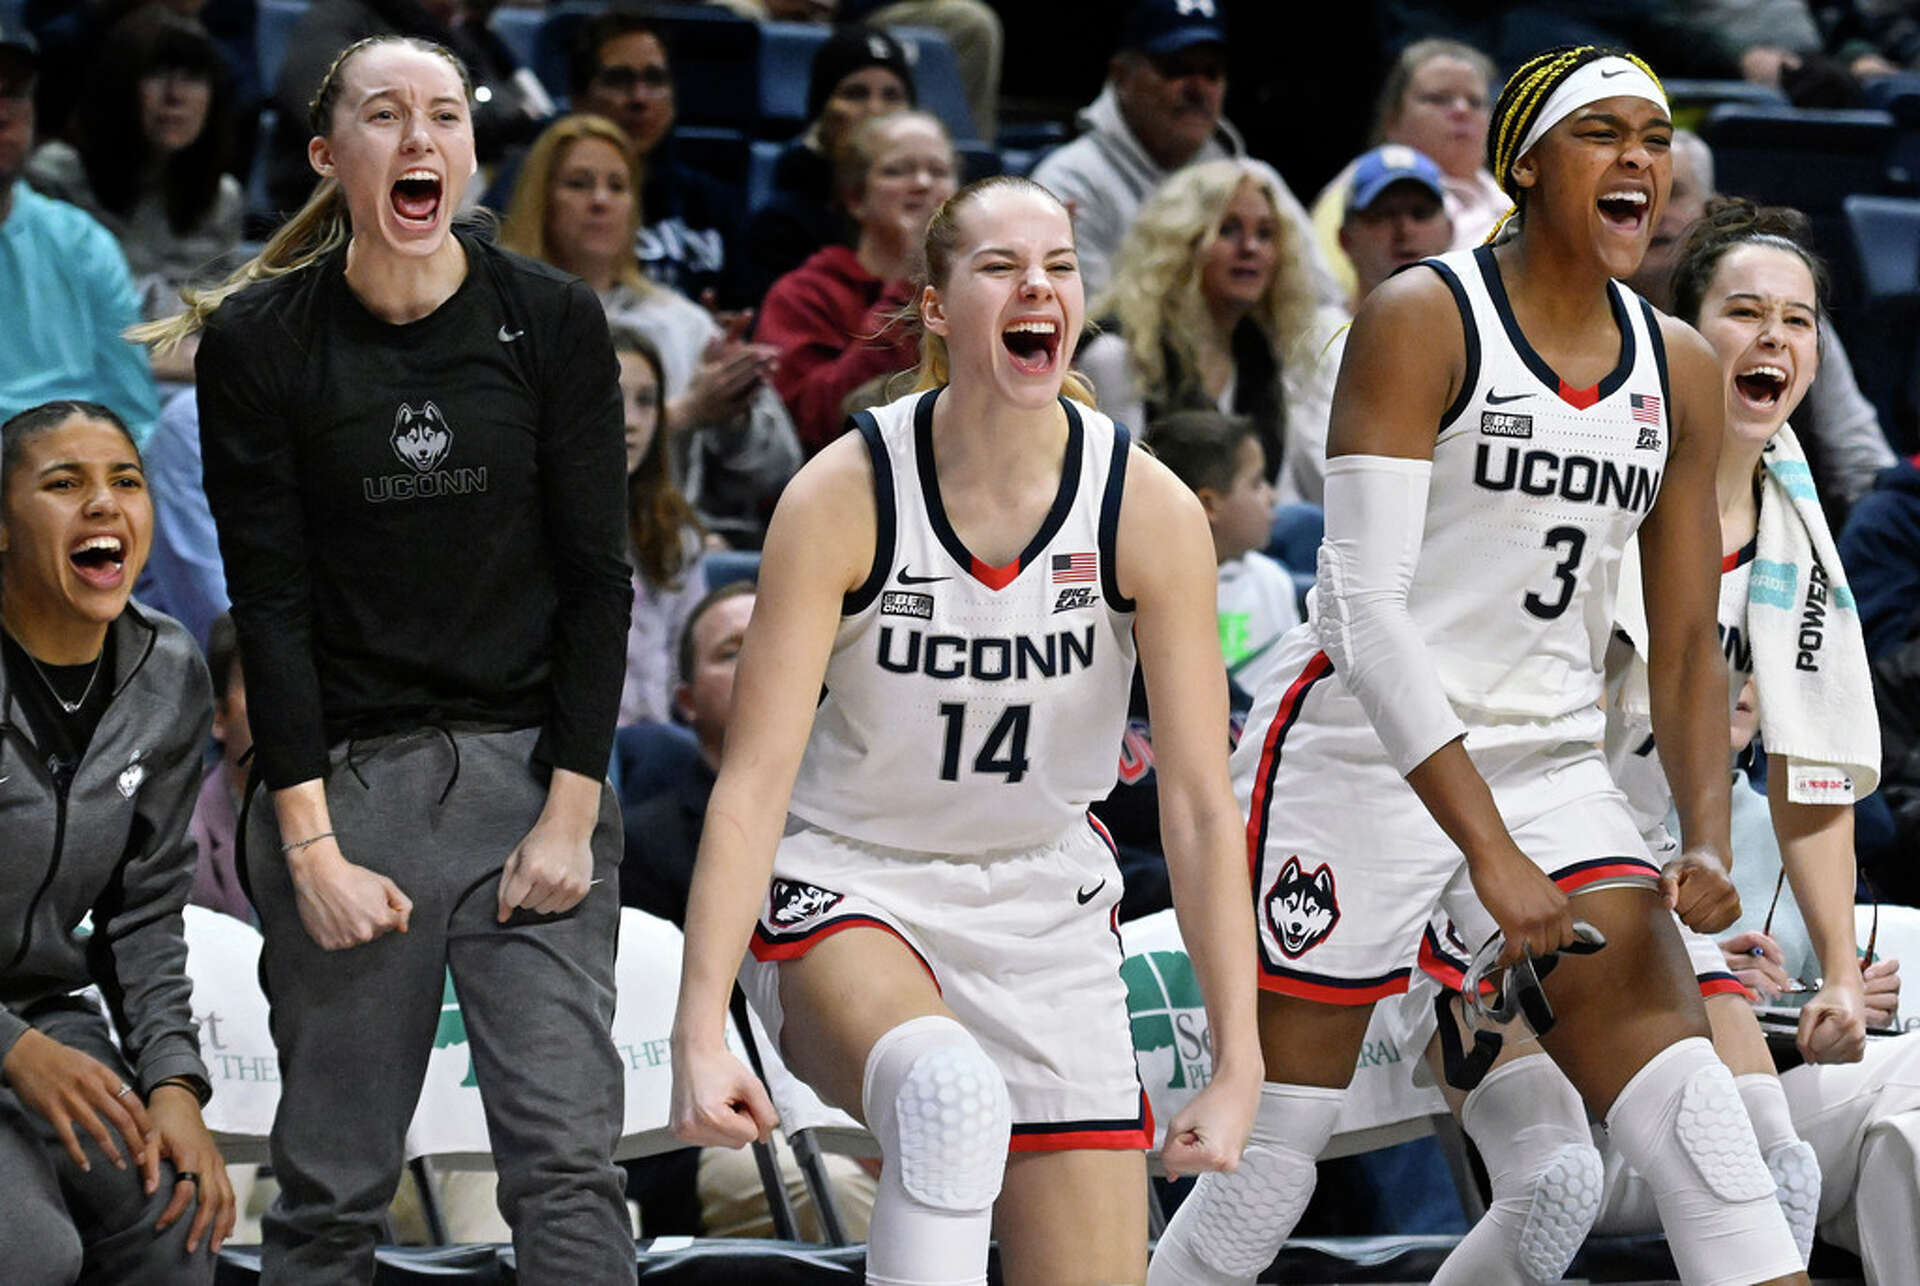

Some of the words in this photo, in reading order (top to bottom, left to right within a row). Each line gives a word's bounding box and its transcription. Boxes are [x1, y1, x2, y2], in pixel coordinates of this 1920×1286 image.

[363, 466, 487, 502] UCONN
[1474, 443, 1659, 514] UCONN
[1521, 524, 1587, 621] 3
[877, 623, 1096, 681] UCONN
[1796, 562, 1828, 672] POWER
[938, 700, 1033, 784] 14
